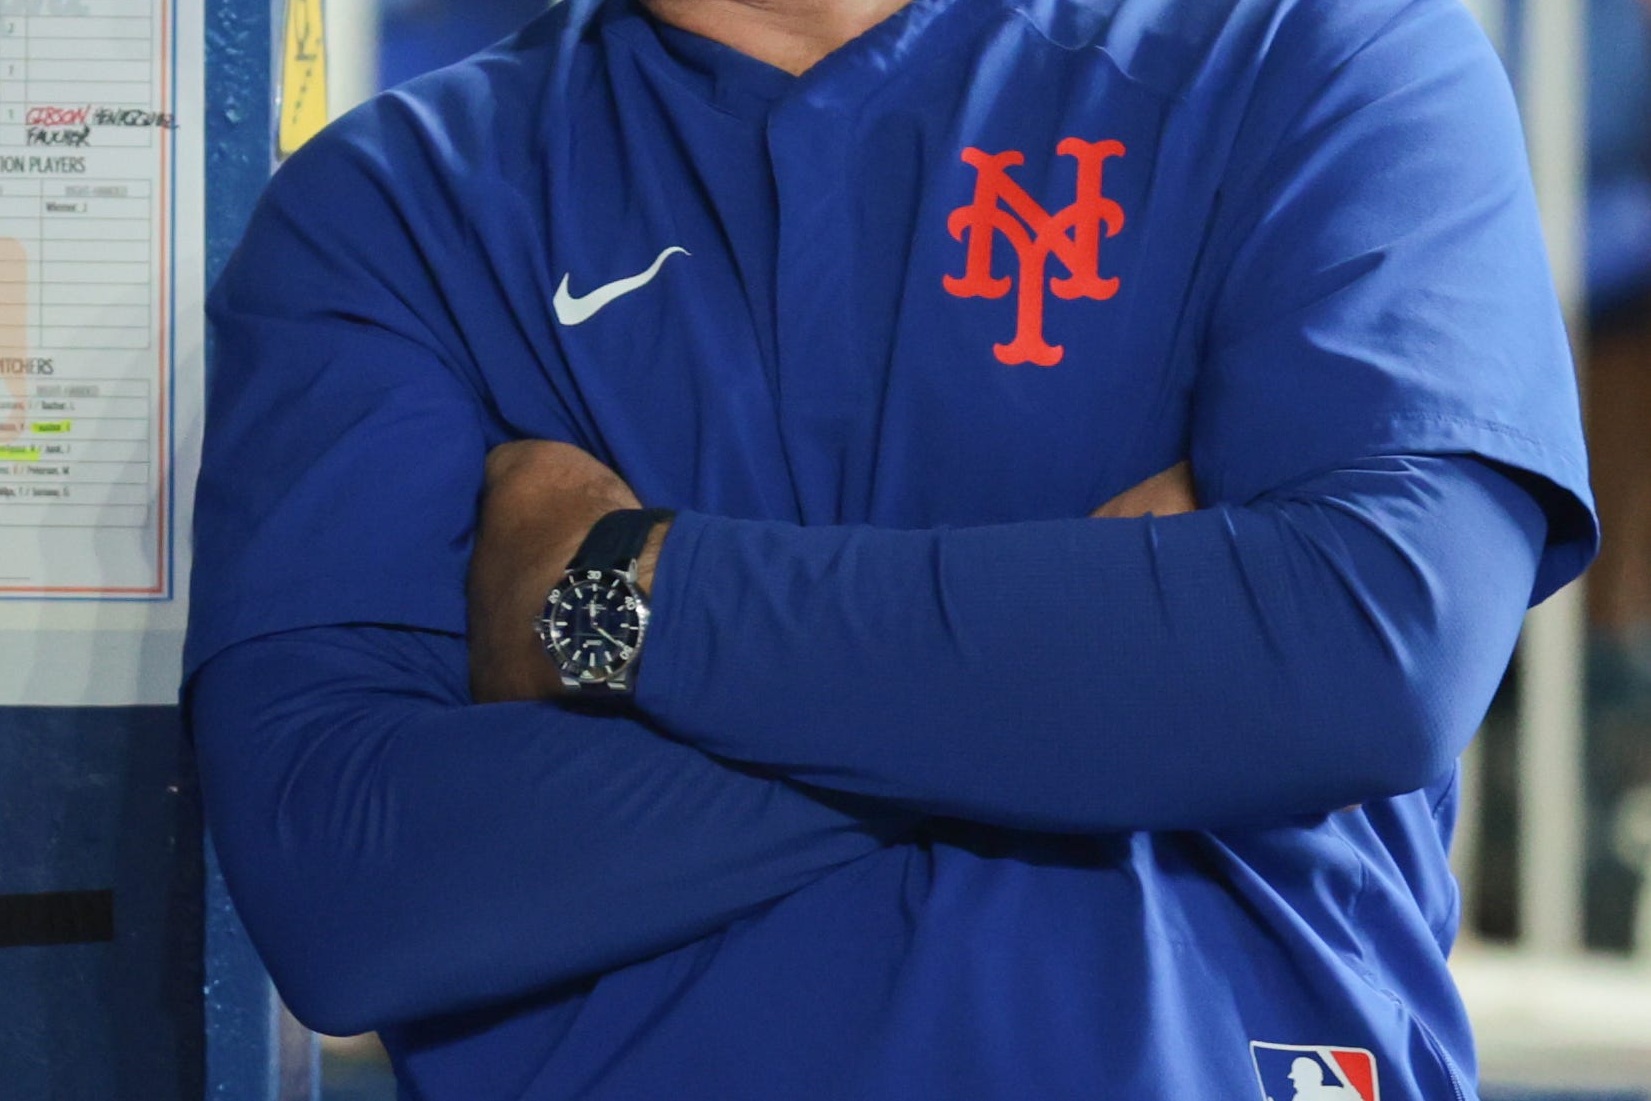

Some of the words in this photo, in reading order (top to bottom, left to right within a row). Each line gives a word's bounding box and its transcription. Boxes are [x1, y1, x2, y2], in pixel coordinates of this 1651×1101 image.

[29, 157, 86, 174] PLAYERS
[944, 137, 1126, 366] NY
[587, 570, 602, 580] 30
